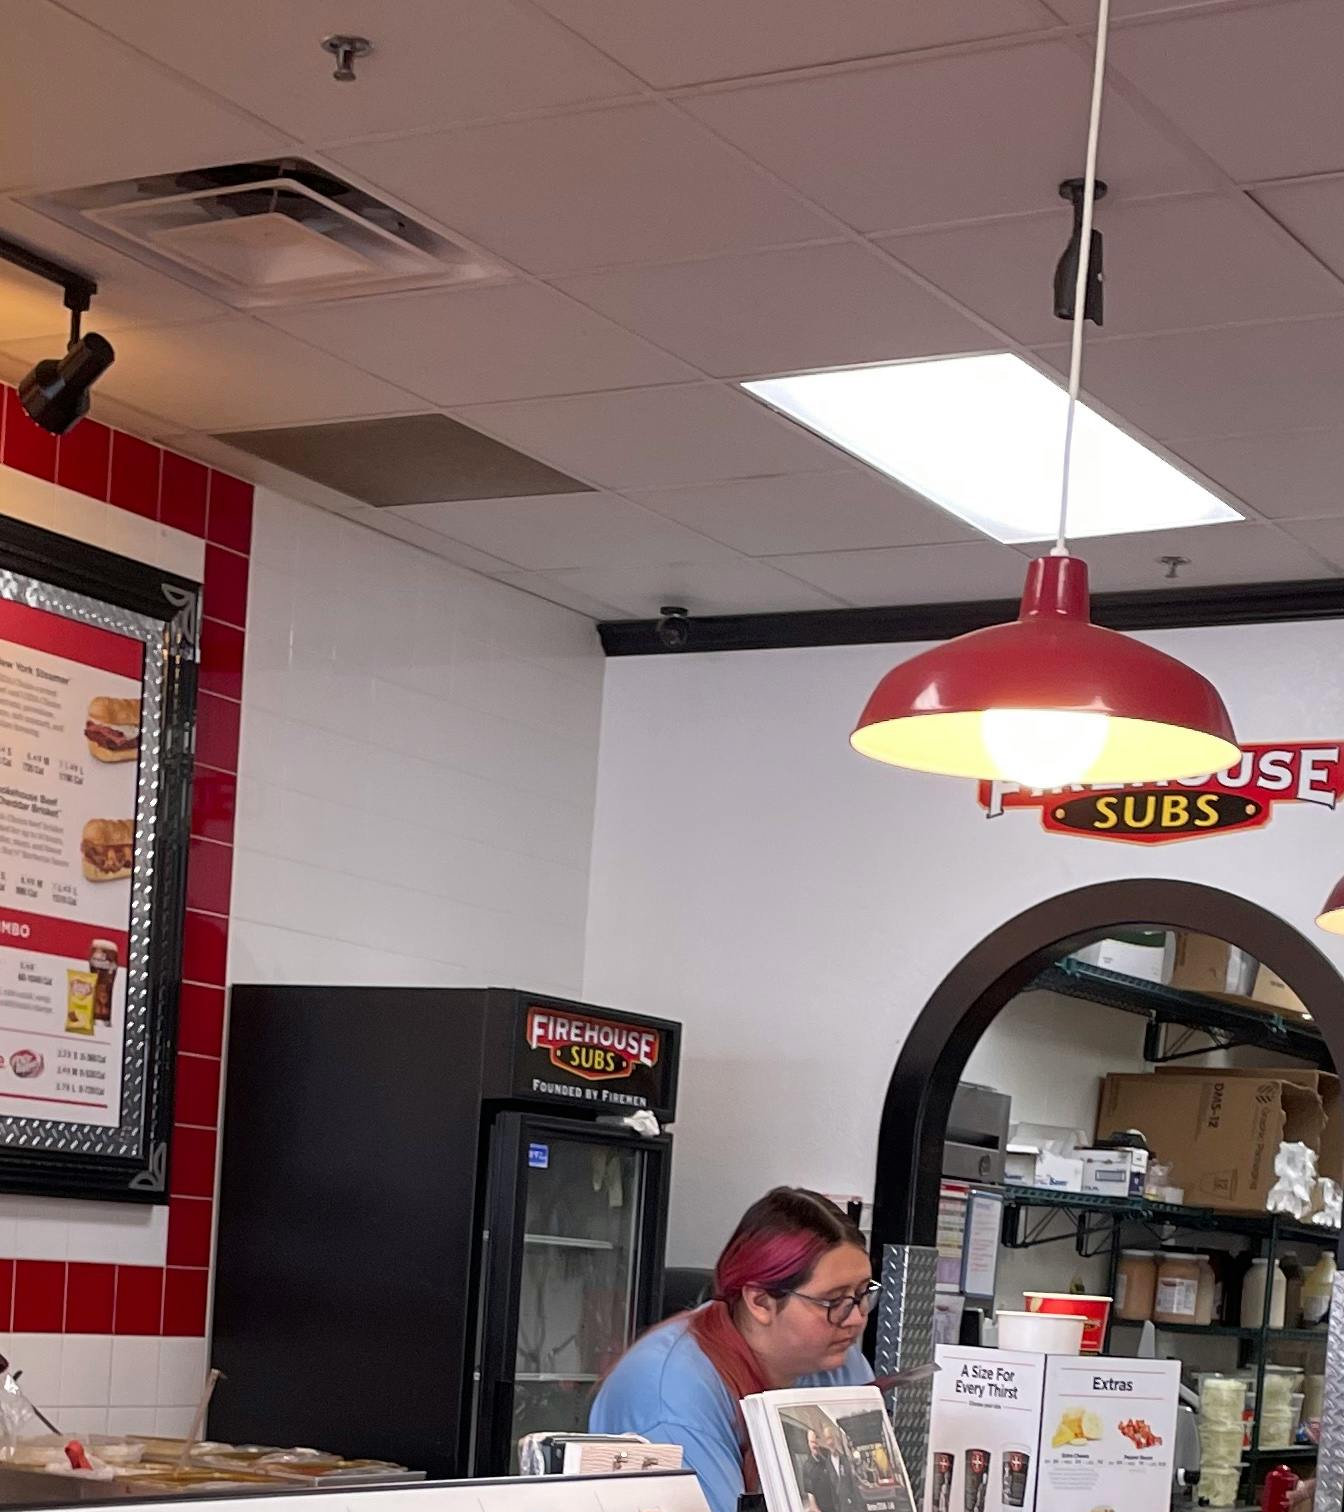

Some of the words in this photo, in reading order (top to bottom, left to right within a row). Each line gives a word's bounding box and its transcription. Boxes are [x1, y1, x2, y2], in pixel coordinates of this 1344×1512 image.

[1093, 794, 1220, 829] SUBS
[532, 1014, 655, 1068] FIREHOUSE
[570, 1045, 616, 1072] SUBS
[585, 1087, 599, 1101] BY
[960, 1364, 970, 1379] A
[971, 1365, 994, 1381] Size
[996, 1368, 1016, 1382] For
[955, 1380, 986, 1399] Every
[988, 1384, 1019, 1400] Thirst
[1092, 1376, 1134, 1392] Extras
